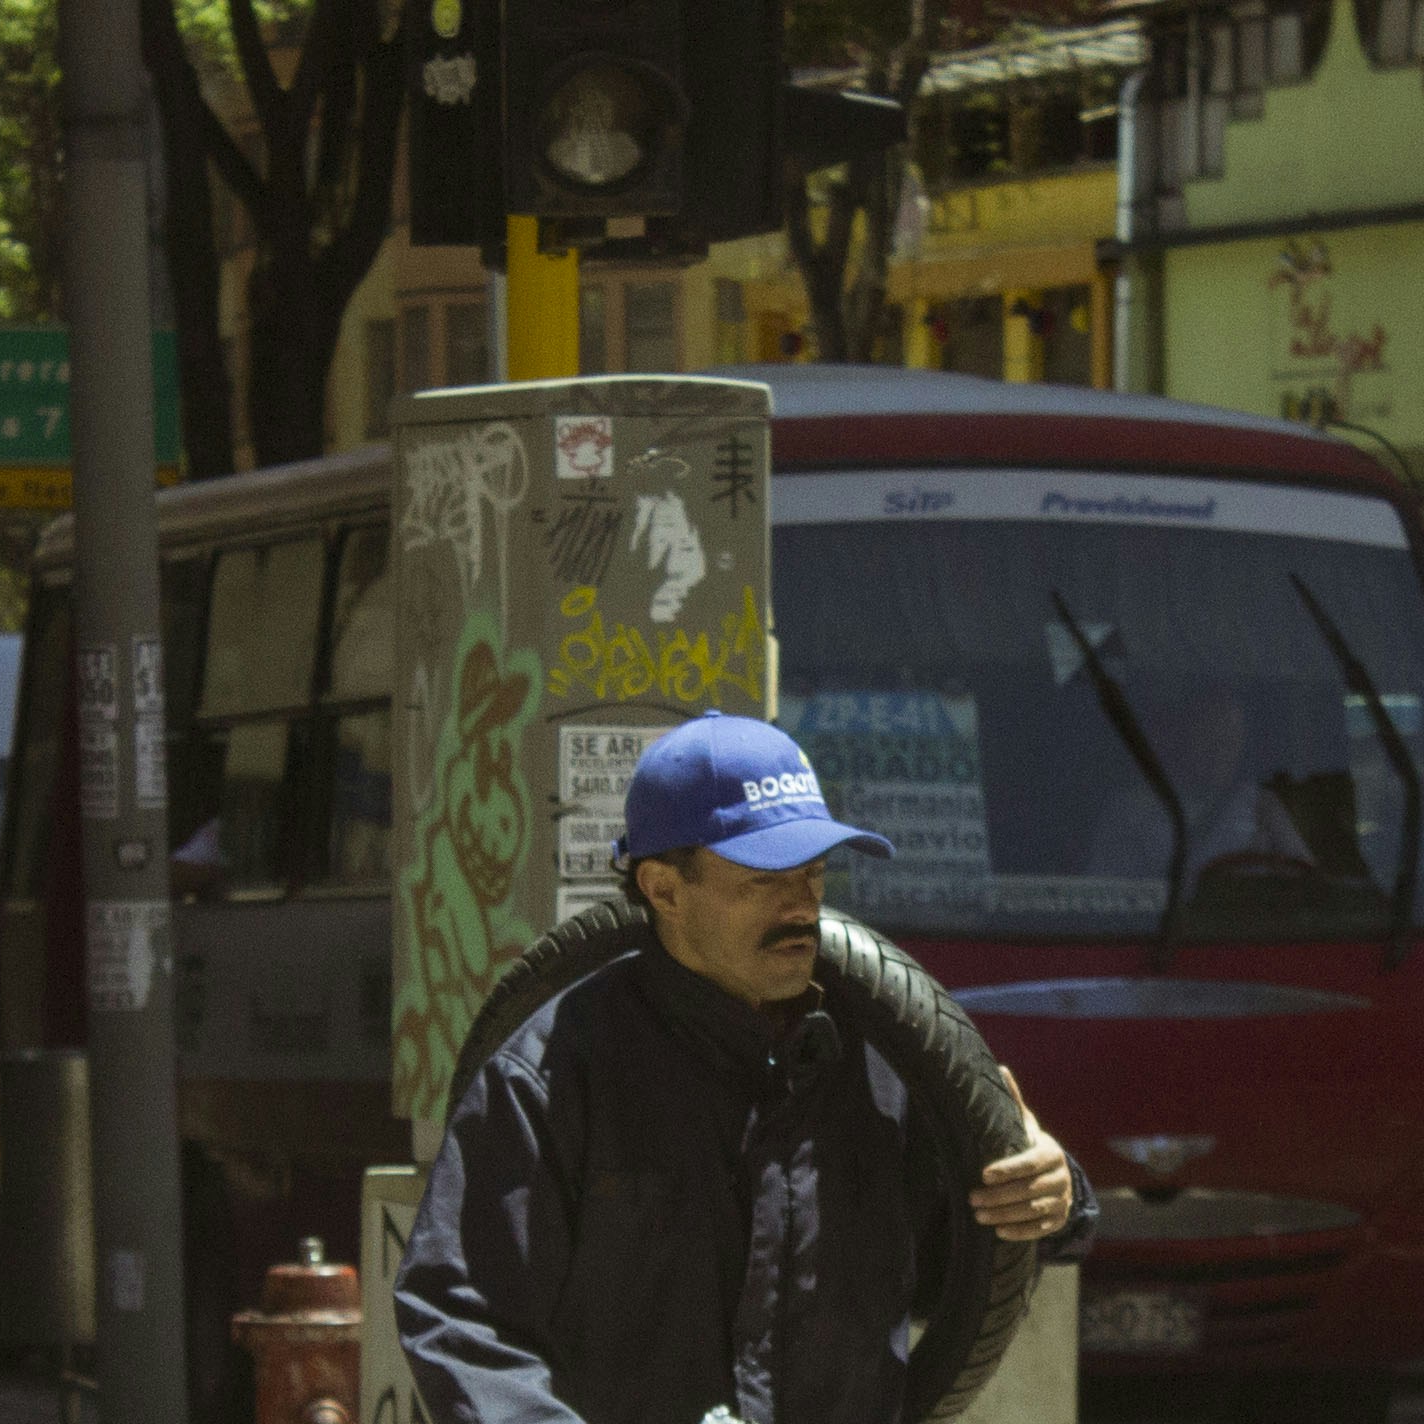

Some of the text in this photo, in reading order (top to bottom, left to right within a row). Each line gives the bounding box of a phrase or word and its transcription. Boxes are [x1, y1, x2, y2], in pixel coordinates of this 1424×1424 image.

[35, 405, 64, 440] 7
[1040, 490, 1217, 521] Provisional
[571, 735, 599, 757] SE
